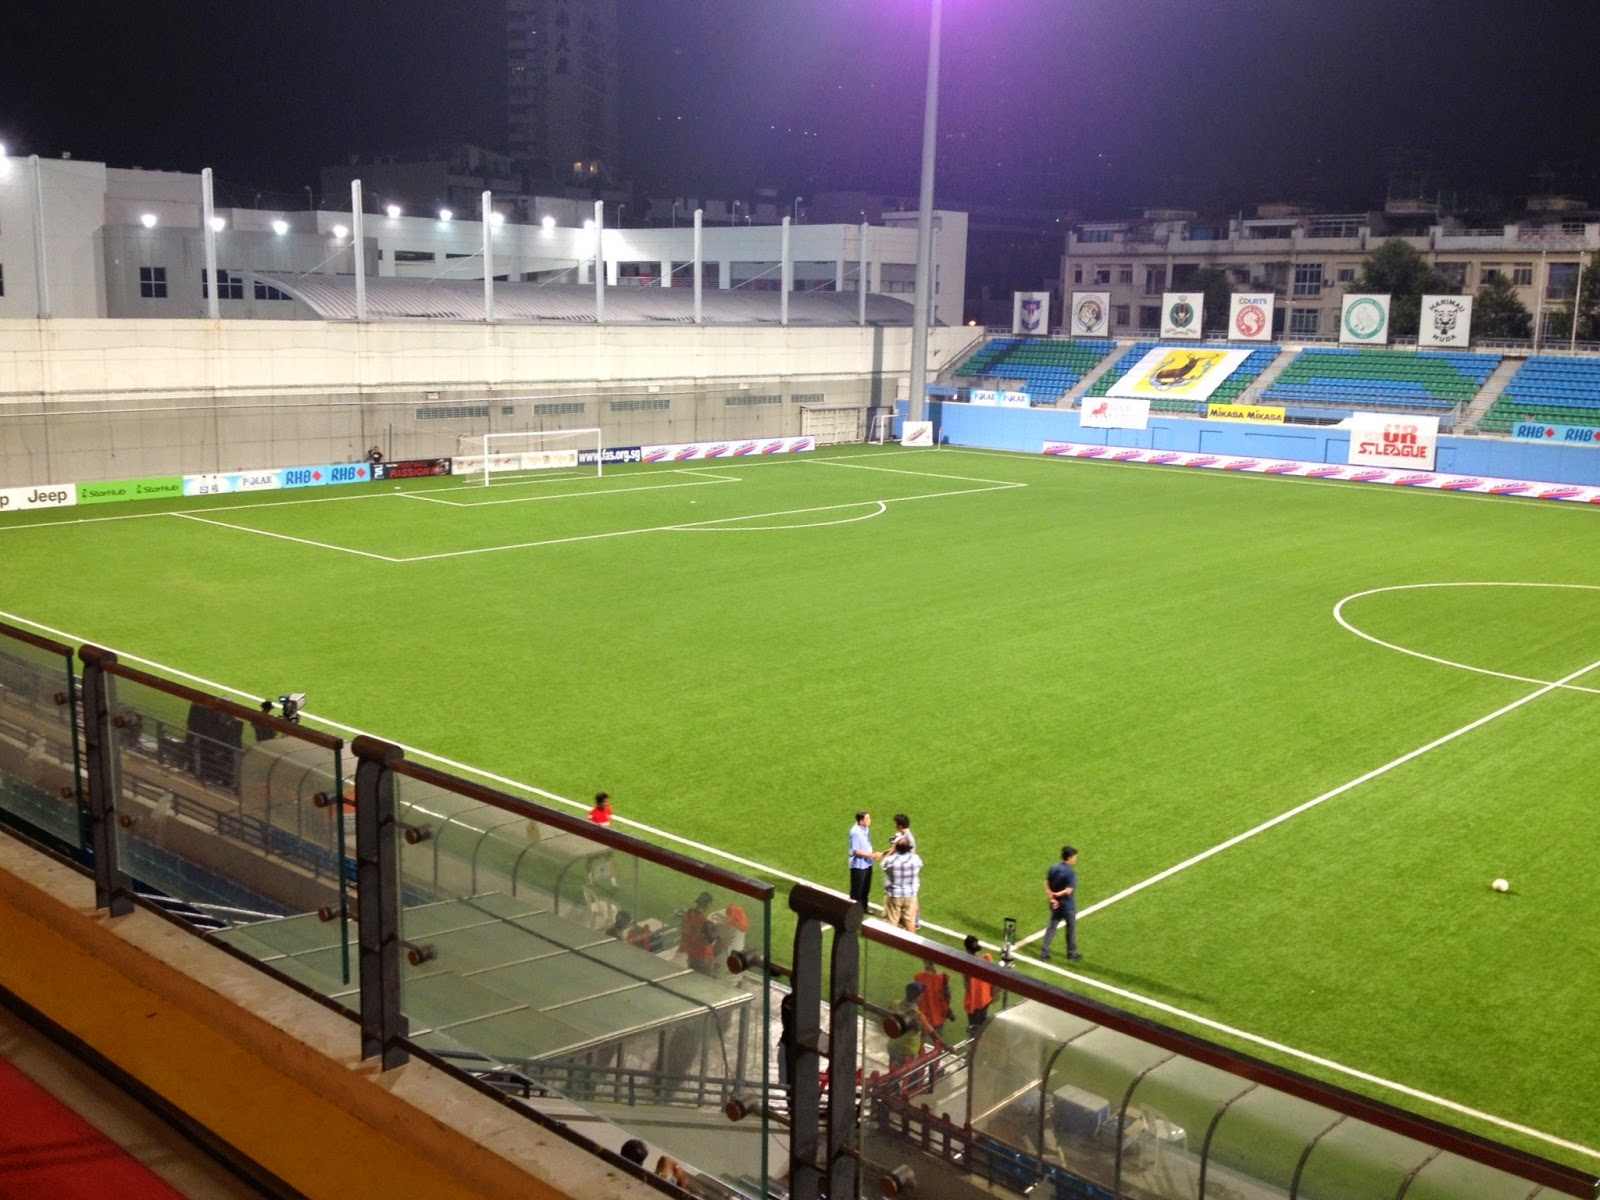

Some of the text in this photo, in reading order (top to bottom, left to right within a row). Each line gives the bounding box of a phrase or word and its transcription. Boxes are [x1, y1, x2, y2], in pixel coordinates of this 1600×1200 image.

[1239, 297, 1268, 305] COURTS
[1429, 298, 1466, 313] HARIMAU
[1432, 333, 1457, 343] MUDA
[1517, 424, 1594, 442] RHB RHB
[243, 476, 272, 486] POLAR
[286, 466, 356, 485] RHB RHB
[27, 489, 68, 504] Jeep
[89, 484, 180, 498] StarHub StarHub
